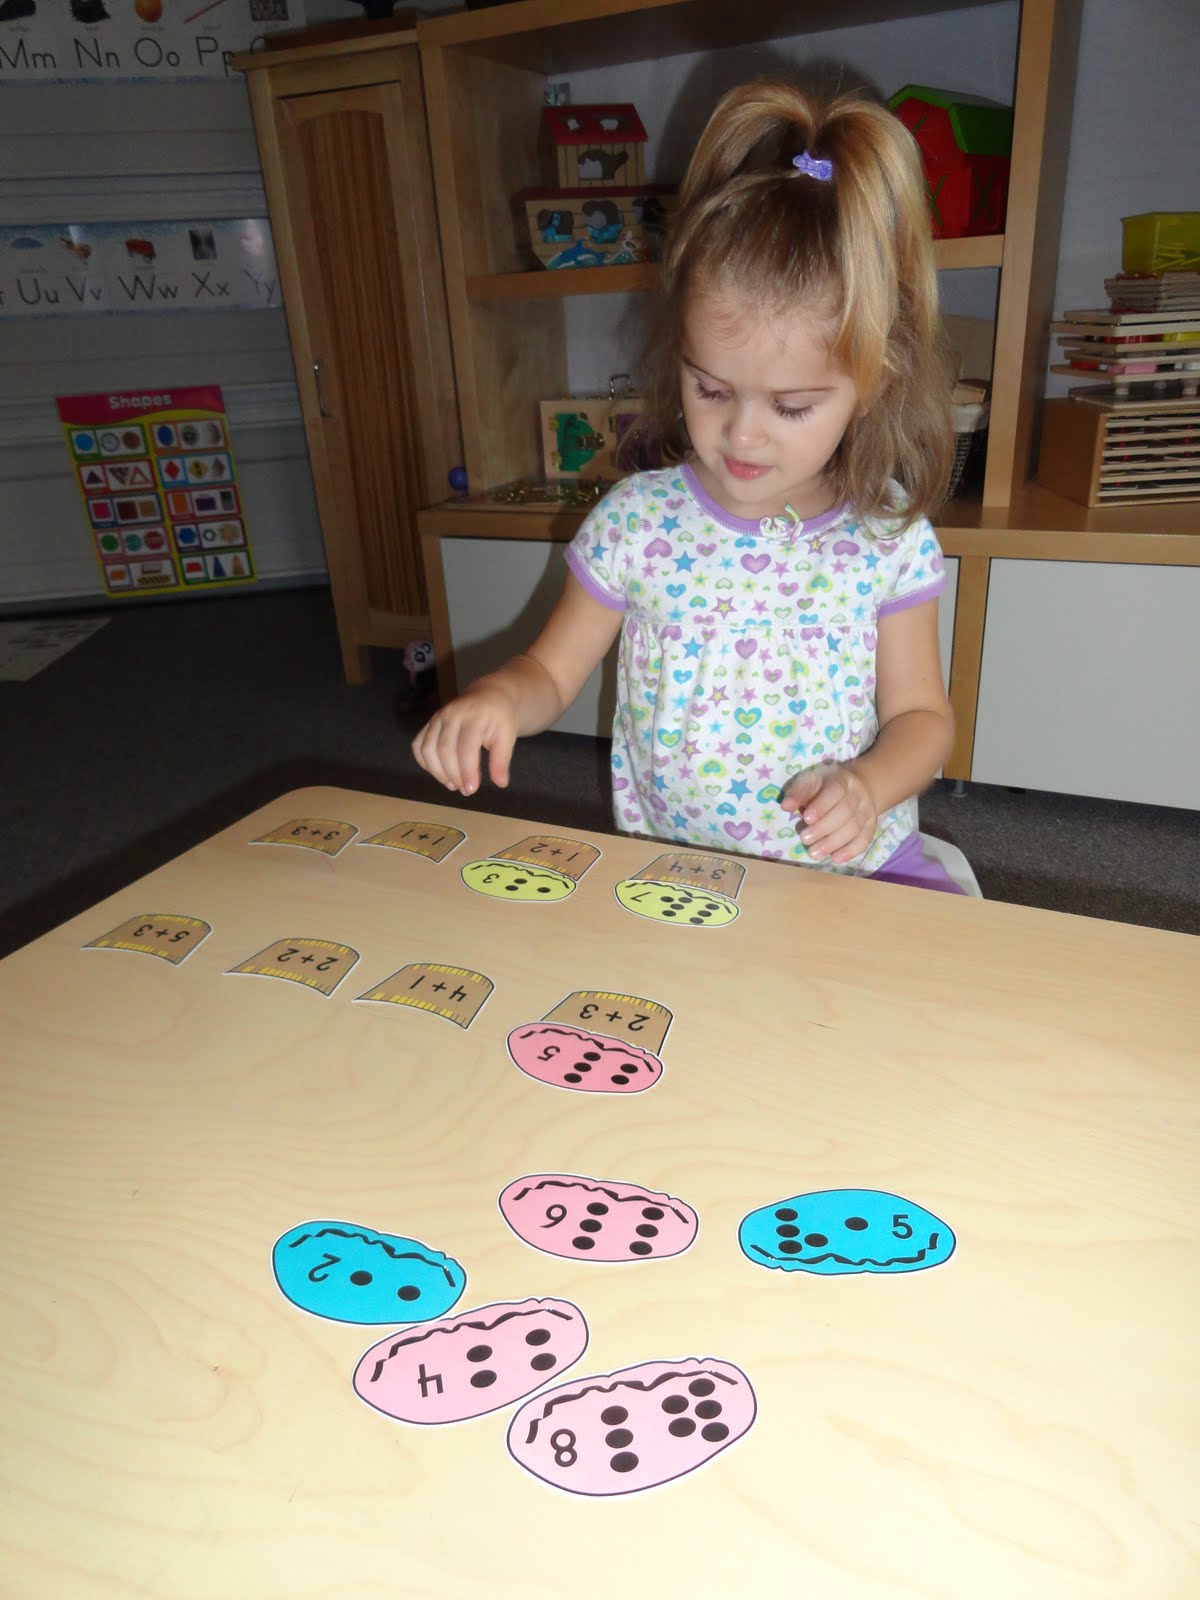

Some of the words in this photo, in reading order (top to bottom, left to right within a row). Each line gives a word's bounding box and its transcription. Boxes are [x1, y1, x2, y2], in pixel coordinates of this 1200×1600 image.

[0, 38, 56, 69] Mm
[74, 37, 120, 69] Nn
[134, 37, 180, 67] Oo
[16, 277, 60, 305] Uu
[65, 275, 102, 302] Vv
[118, 273, 178, 301] Ww
[192, 271, 230, 298] Xx
[244, 269, 276, 302] Yy
[108, 394, 172, 410] Shapes
[482, 873, 499, 884] 3
[630, 891, 652, 903] 7
[537, 1045, 560, 1061] 5
[891, 1214, 914, 1240] 5
[308, 1253, 340, 1283] 2
[417, 1363, 444, 1398] 4
[549, 1428, 579, 1468] 8
